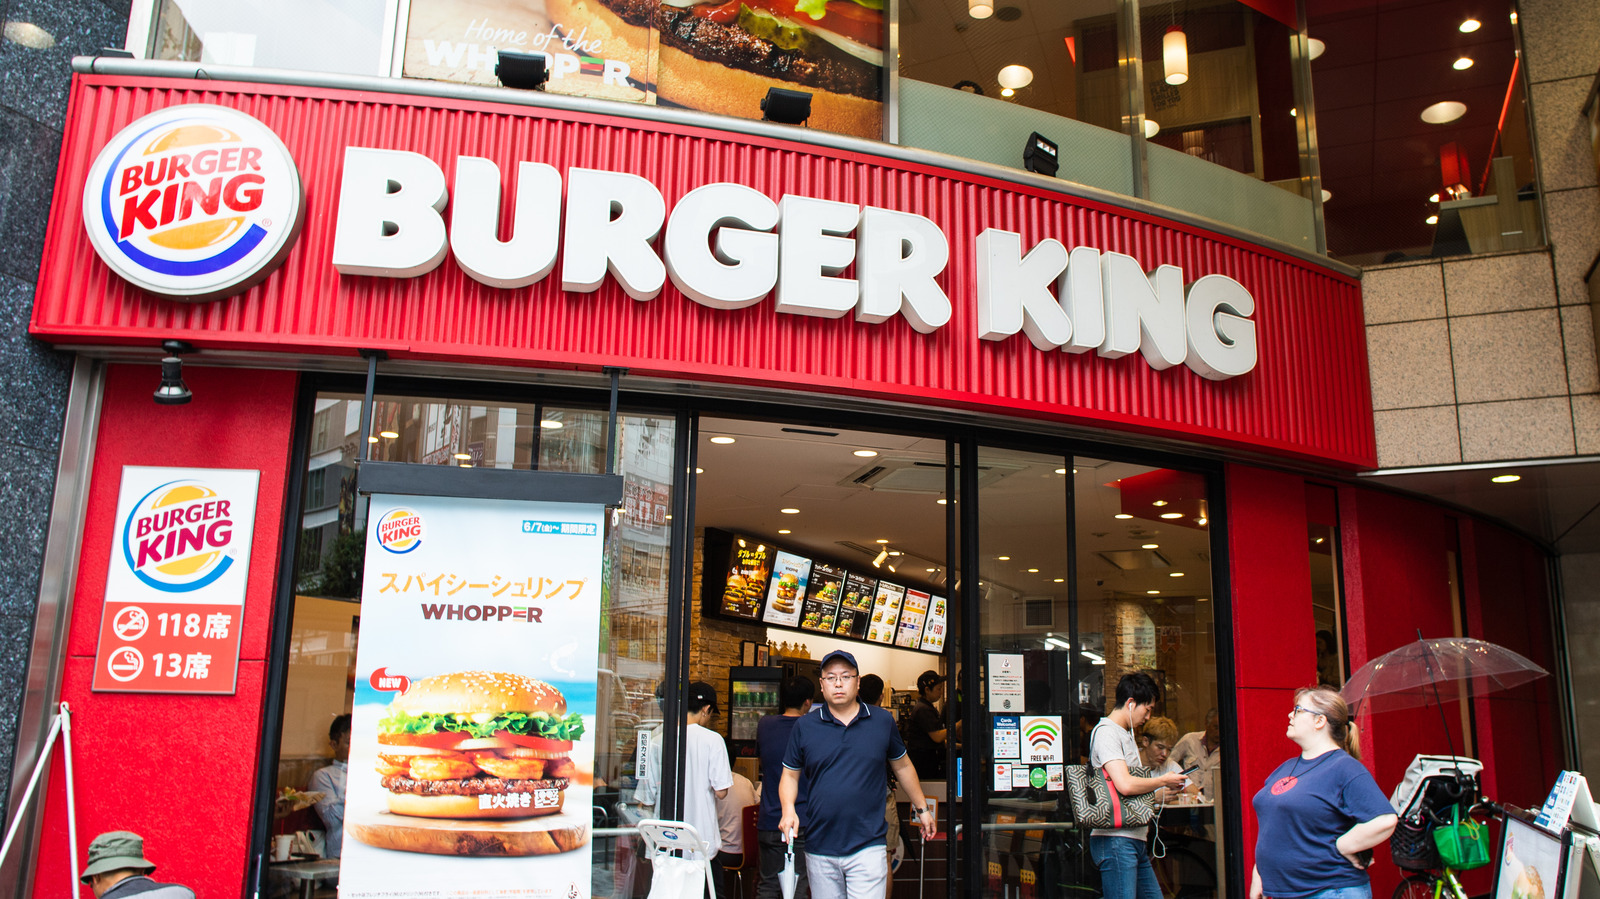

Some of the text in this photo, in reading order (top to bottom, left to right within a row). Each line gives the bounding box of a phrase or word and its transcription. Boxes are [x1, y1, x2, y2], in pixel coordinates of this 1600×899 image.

[464, 17, 602, 54] Home of the
[423, 39, 633, 87] WHPER
[119, 147, 263, 197] BURGER
[120, 173, 266, 240] KING
[332, 145, 1257, 381] BURGER KING
[136, 500, 231, 539] BURGER
[381, 516, 420, 533] BURGER
[560, 523, 596, 535] 期間限定
[136, 519, 233, 569] KING
[382, 525, 421, 545] KING
[379, 572, 589, 601] スパイシーシュリンプ
[157, 612, 232, 640] 118席
[421, 603, 544, 623] WHOPPER
[152, 651, 212, 680] 13席
[378, 677, 402, 689] NEW
[639, 733, 648, 777] 防犯カメラ設置
[1030, 754, 1042, 762] FREE
[478, 792, 532, 810] 直火焼き
